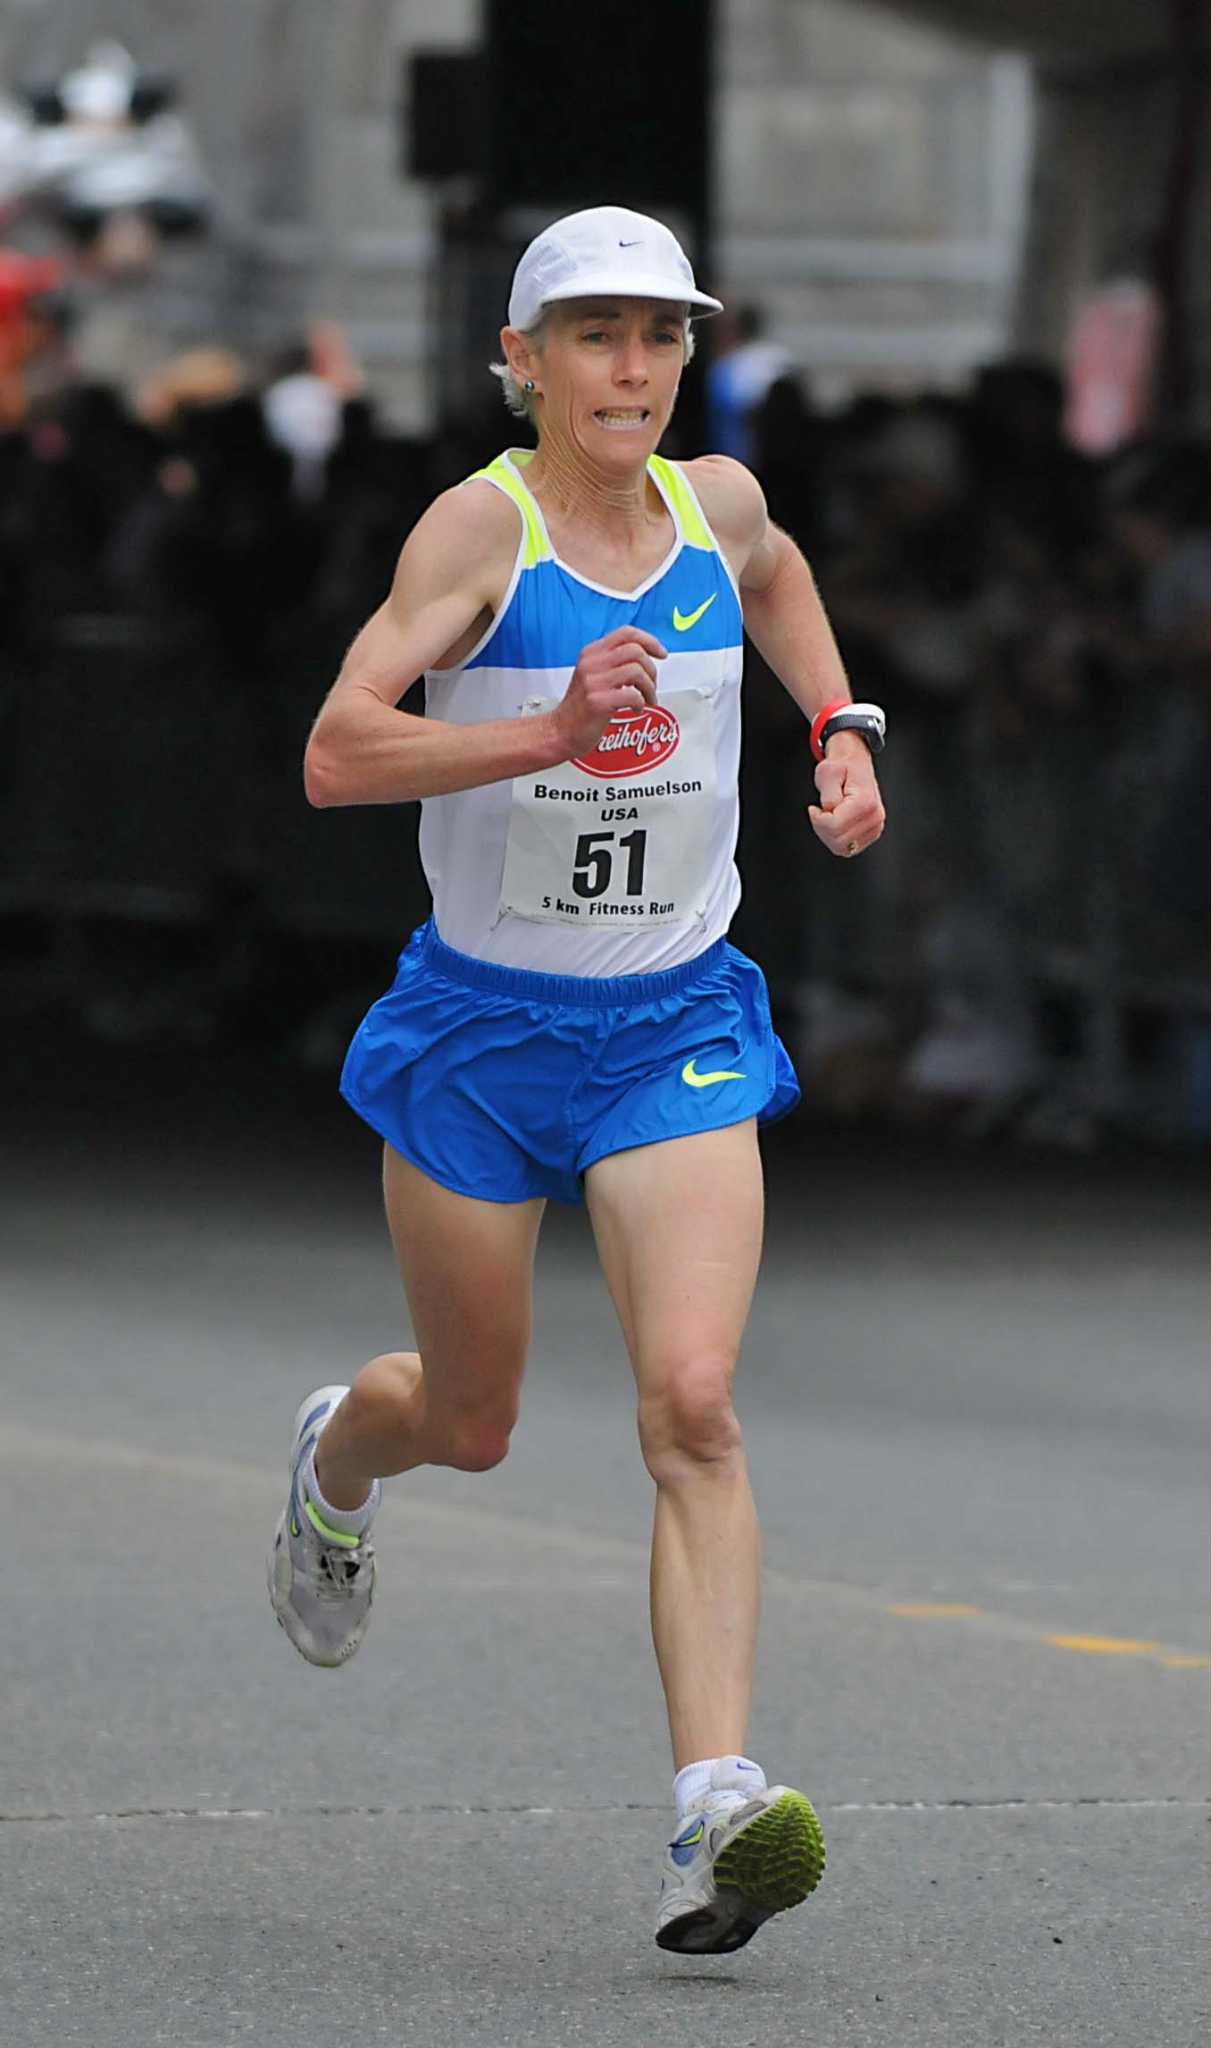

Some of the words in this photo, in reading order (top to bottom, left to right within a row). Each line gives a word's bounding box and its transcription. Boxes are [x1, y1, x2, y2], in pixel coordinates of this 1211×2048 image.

[597, 714, 679, 757] reihofer's
[534, 784, 600, 802] Benoit
[605, 780, 702, 801] Samuelson
[601, 807, 639, 822] USA
[572, 829, 647, 899] 51
[541, 896, 551, 909] 5
[556, 898, 580, 915] km
[589, 902, 644, 916] Fitness
[650, 902, 674, 915] Run
